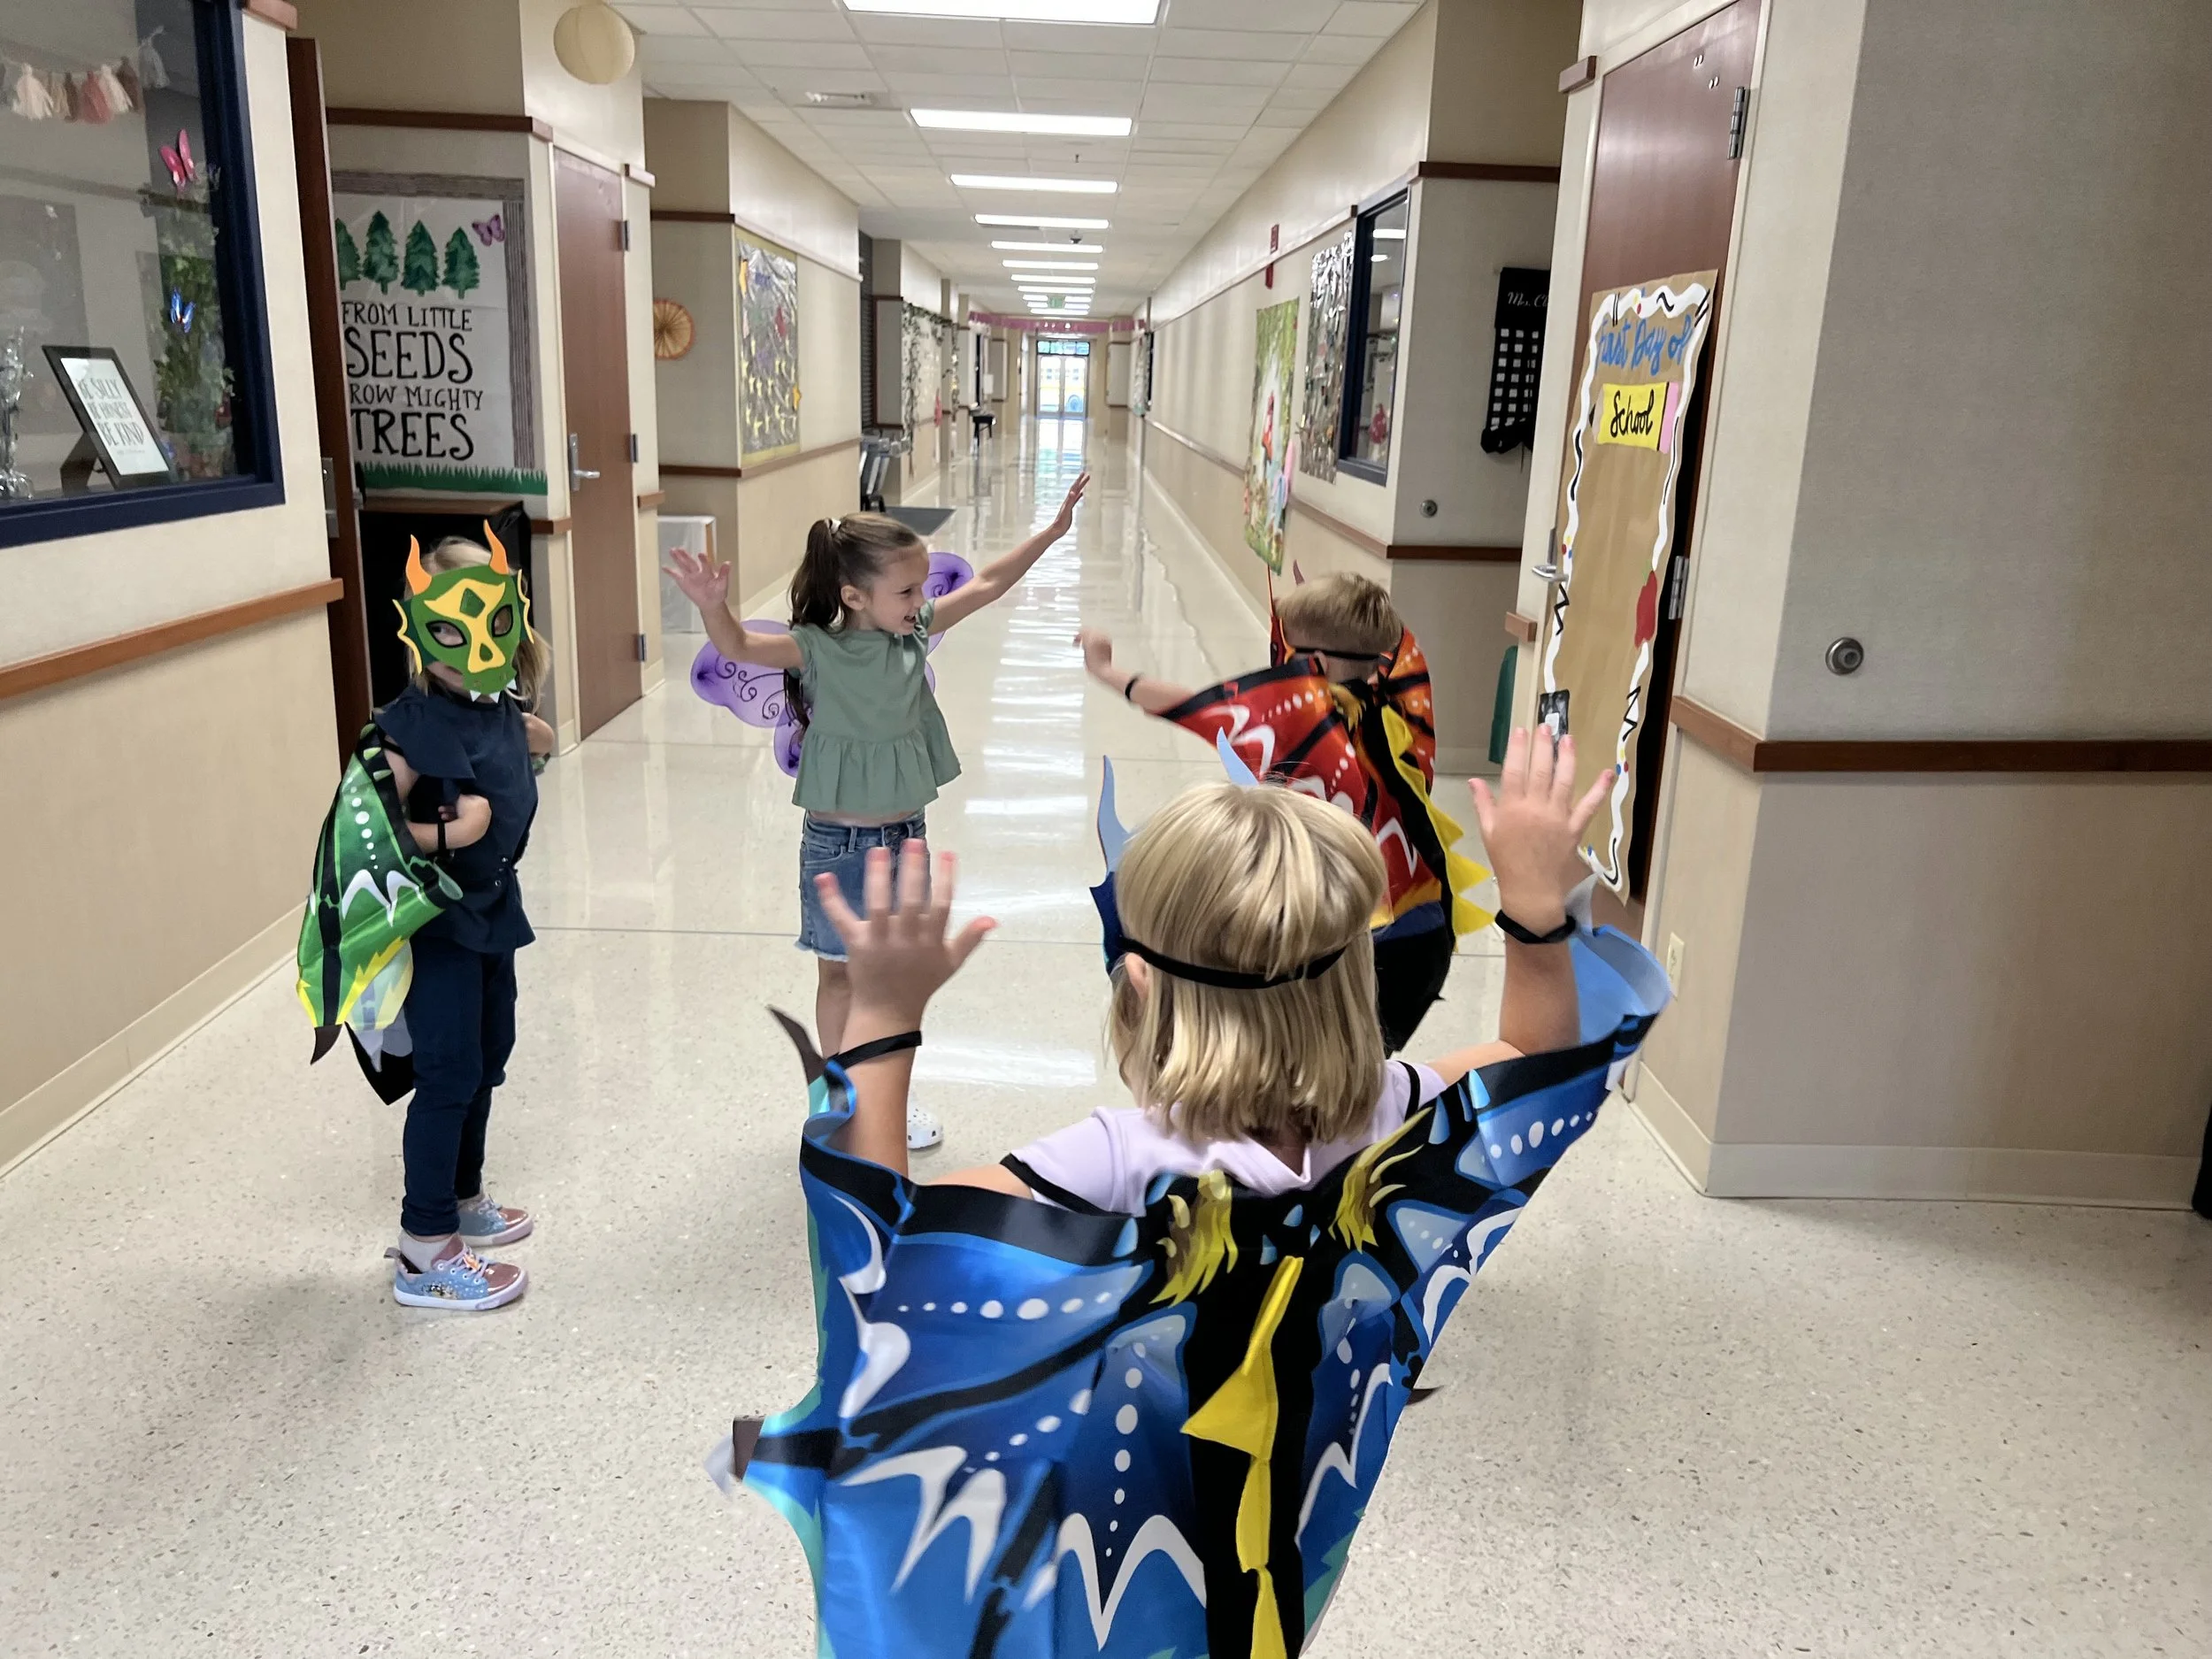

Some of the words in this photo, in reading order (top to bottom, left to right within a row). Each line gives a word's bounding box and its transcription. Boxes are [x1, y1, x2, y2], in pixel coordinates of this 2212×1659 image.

[342, 302, 398, 326] FROM
[408, 306, 472, 331] LITTLE
[344, 326, 472, 384] SEEDS
[1631, 319, 1667, 377] Day
[1668, 314, 1693, 365] of
[349, 385, 398, 405] ROW
[405, 385, 483, 411] MIGHTY
[1609, 389, 1654, 438] School
[96, 422, 119, 446] BE
[113, 422, 144, 446] KIND
[351, 408, 474, 461] TREES
